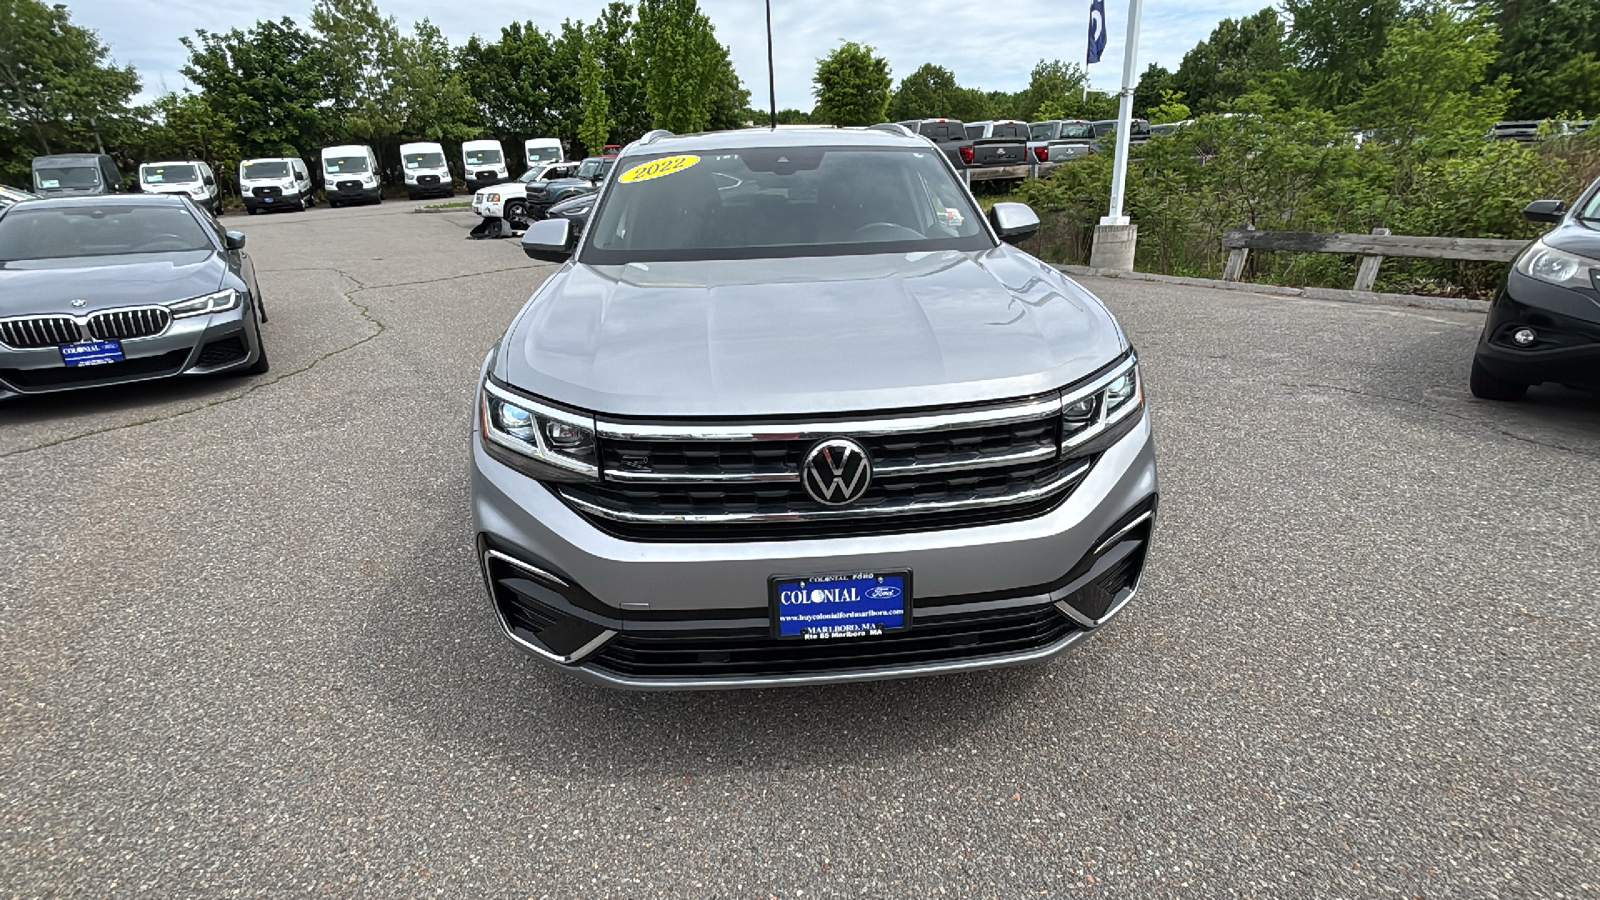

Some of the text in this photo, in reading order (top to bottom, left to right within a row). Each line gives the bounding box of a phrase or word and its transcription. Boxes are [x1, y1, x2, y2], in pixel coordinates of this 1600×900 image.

[633, 158, 686, 180] 2022
[62, 344, 100, 354] COLONIAL
[808, 572, 874, 583] COLONIAL FORD
[780, 587, 861, 605] COLONIAL
[780, 609, 904, 622] www.buycolonialfordmarlboro.com
[862, 623, 876, 631] MA
[831, 630, 866, 639] Marlboro
